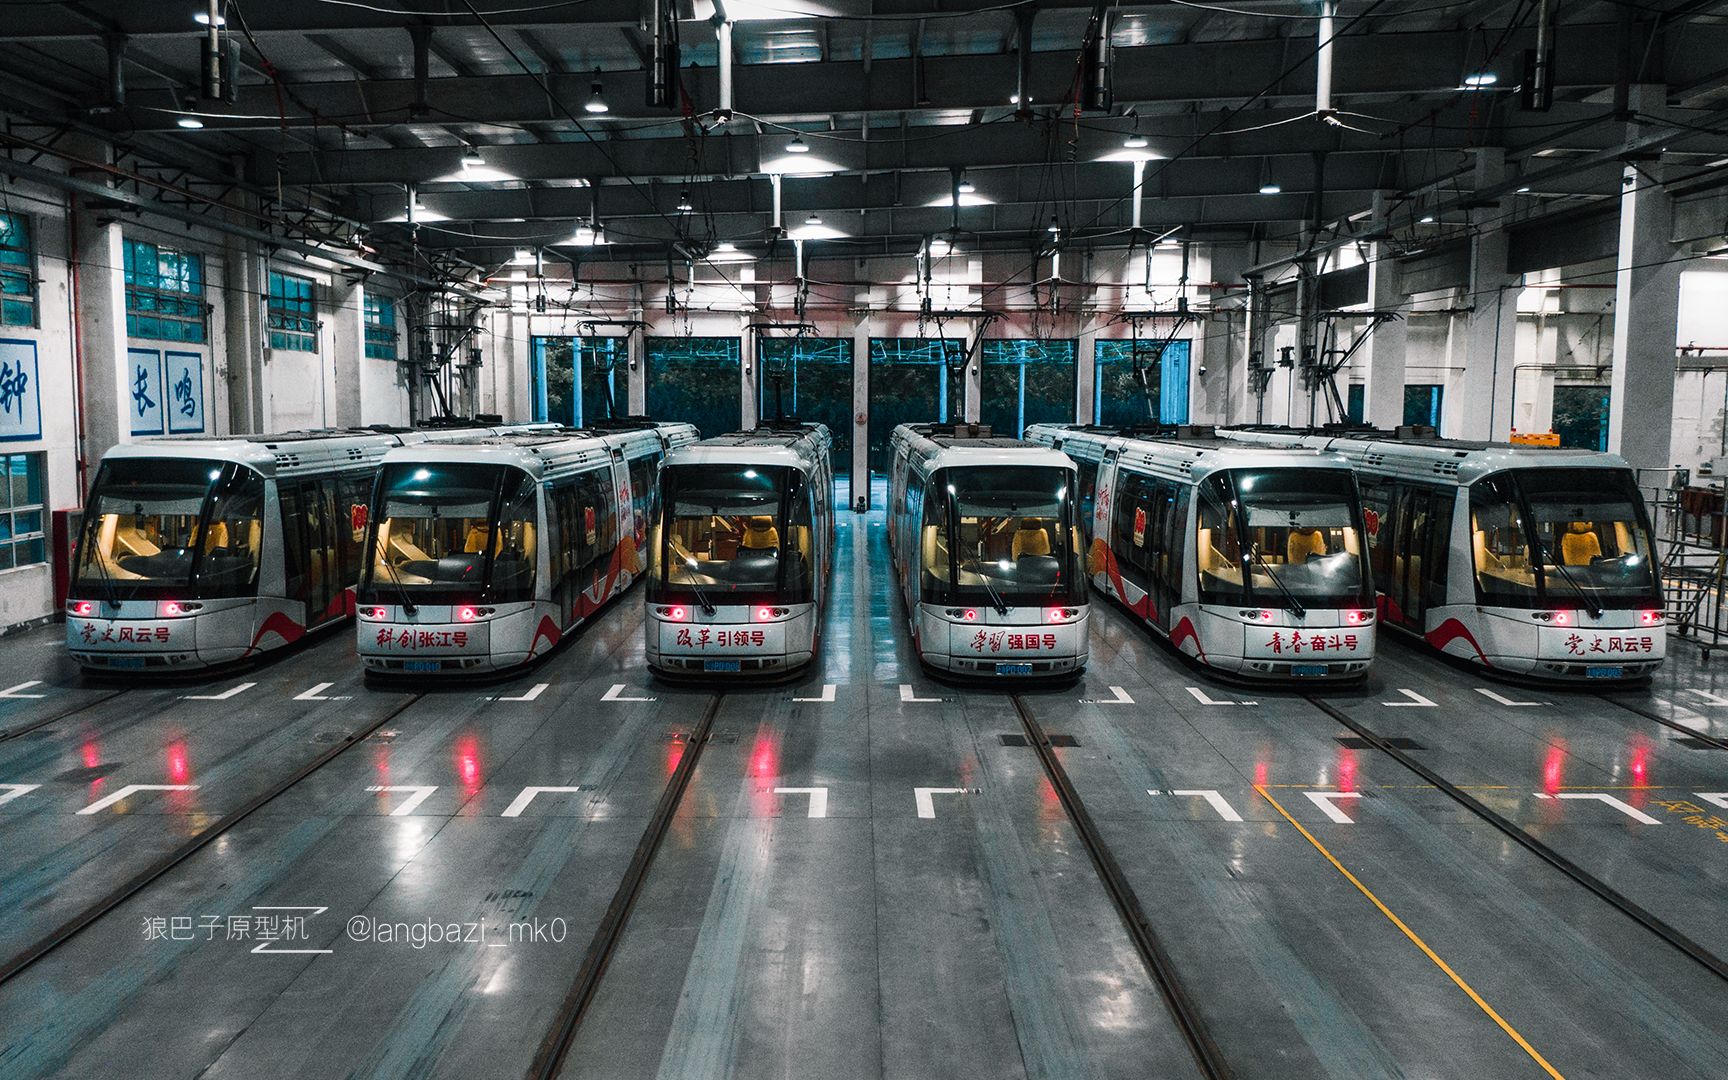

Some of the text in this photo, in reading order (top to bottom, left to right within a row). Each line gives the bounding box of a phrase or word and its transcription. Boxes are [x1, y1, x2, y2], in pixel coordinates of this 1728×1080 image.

[0, 359, 29, 425] 钟
[131, 364, 156, 418] 长
[174, 367, 197, 418] 鸣
[80, 622, 171, 645] 党史风云号
[376, 628, 469, 650] 科创张江号
[676, 628, 766, 650] 改革引领号
[1265, 630, 1359, 654] 青春奋斗号
[1564, 633, 1654, 656] 党史风云号
